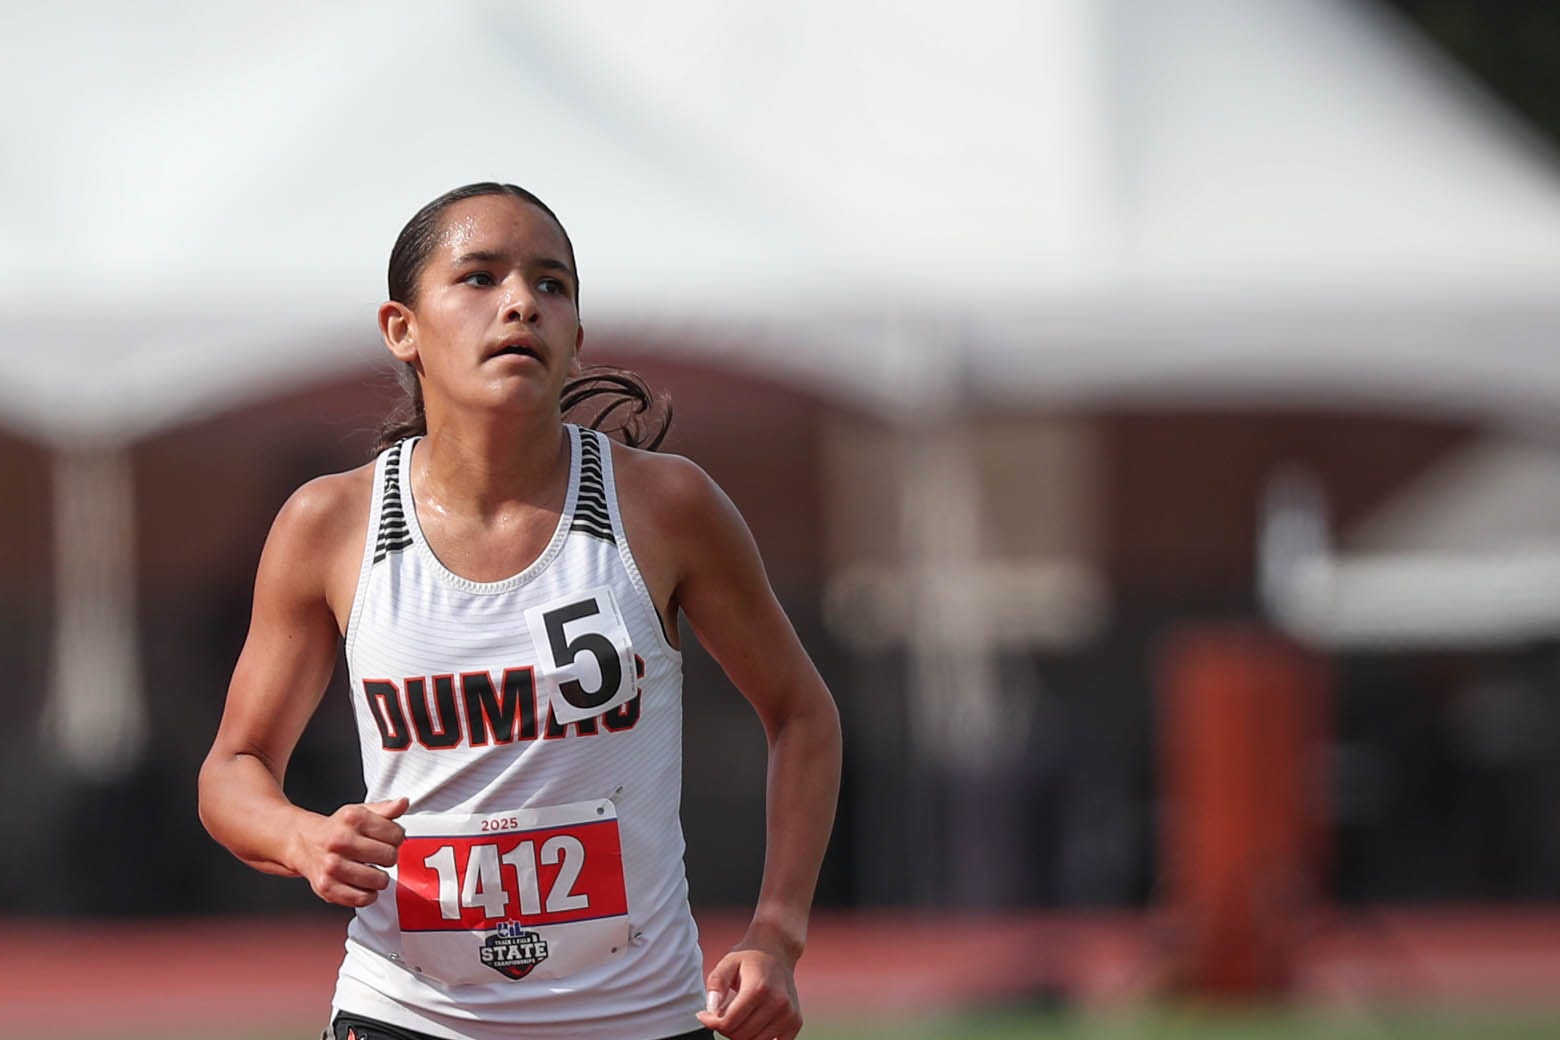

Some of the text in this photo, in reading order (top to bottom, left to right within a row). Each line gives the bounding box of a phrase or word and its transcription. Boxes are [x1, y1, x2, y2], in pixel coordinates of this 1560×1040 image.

[542, 597, 622, 709] 5
[481, 817, 519, 832] 2025
[424, 834, 590, 920] 1412
[481, 942, 547, 961] STATE
